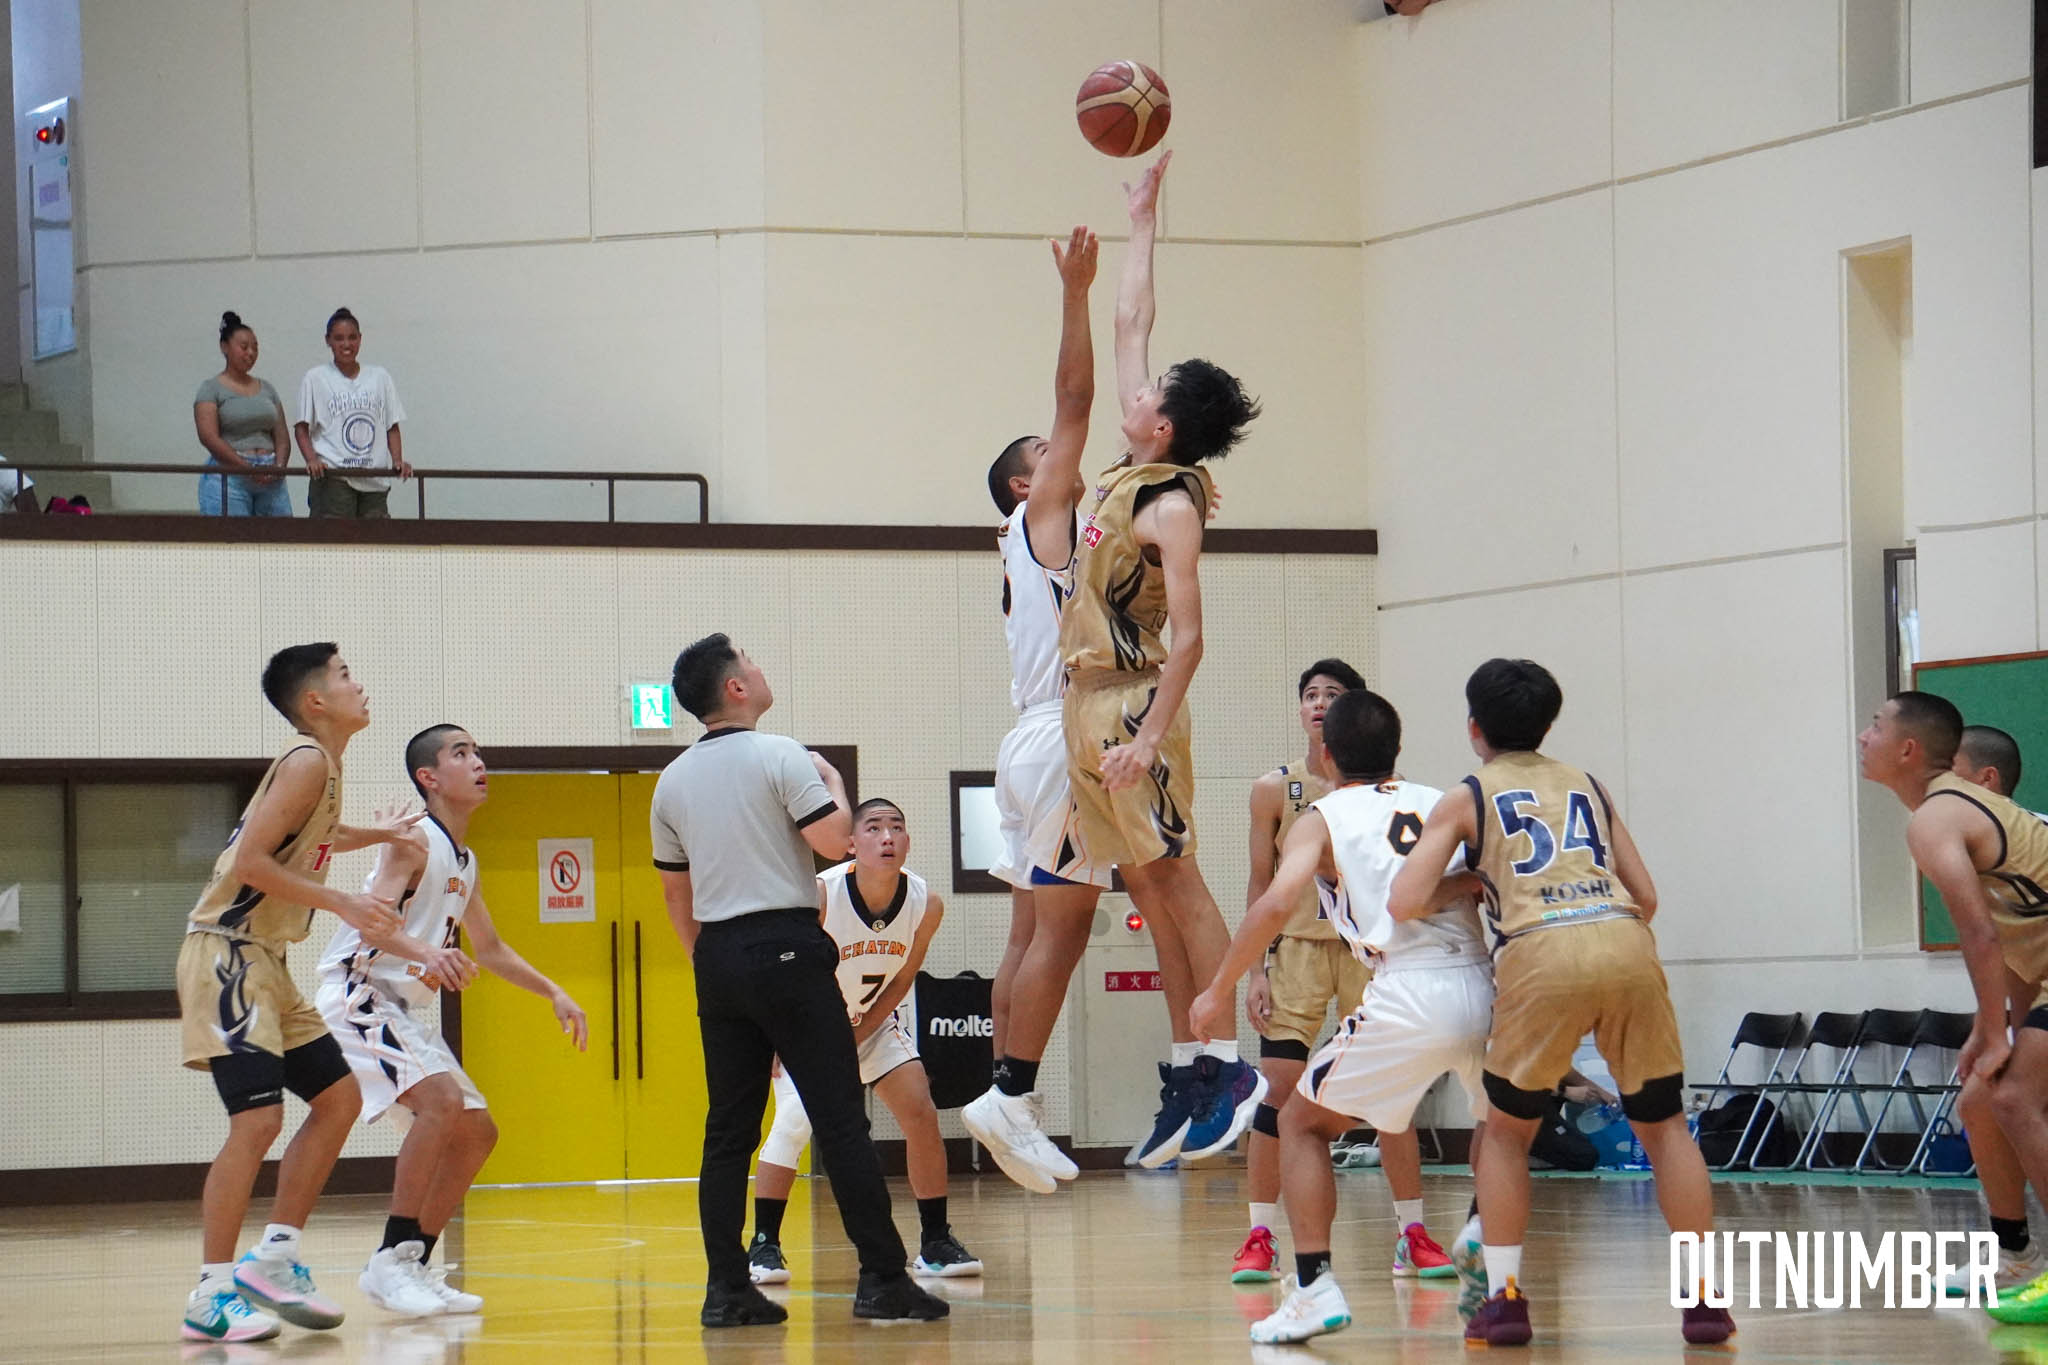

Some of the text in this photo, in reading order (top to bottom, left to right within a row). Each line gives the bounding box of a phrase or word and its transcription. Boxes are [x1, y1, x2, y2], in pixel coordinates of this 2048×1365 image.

[1492, 789, 1608, 877] 54
[1541, 879, 1614, 904] KOSHI
[841, 940, 907, 960] CHATAN
[859, 974, 887, 1006] 7
